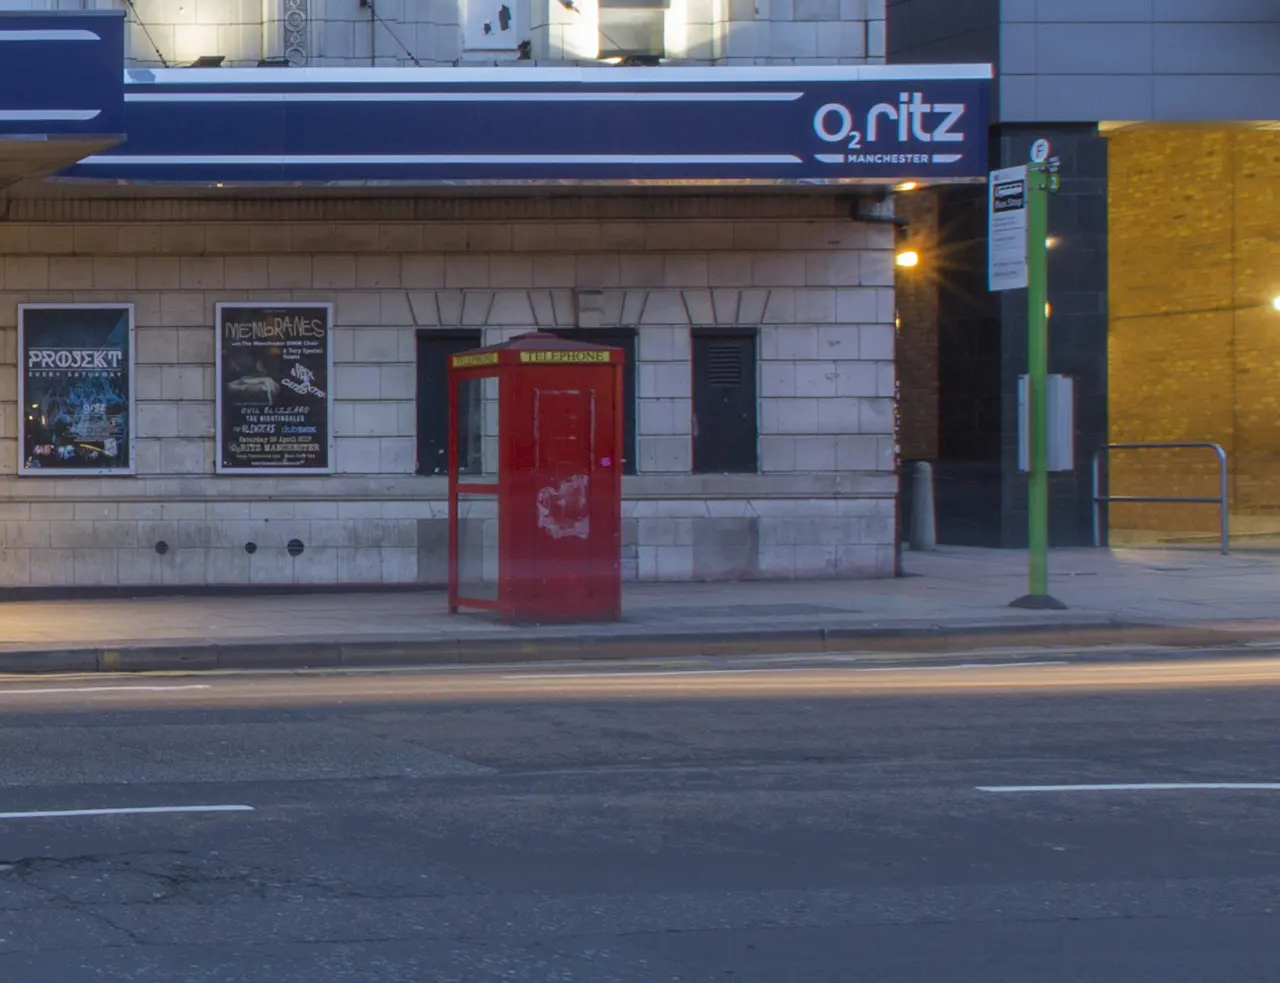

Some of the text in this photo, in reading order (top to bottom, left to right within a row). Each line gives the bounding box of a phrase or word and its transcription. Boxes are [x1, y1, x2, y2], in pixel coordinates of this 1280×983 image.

[848, 154, 929, 163] MANCHESTER
[28, 351, 122, 367] PROJEKT
[526, 352, 604, 362] TELEPHONE
